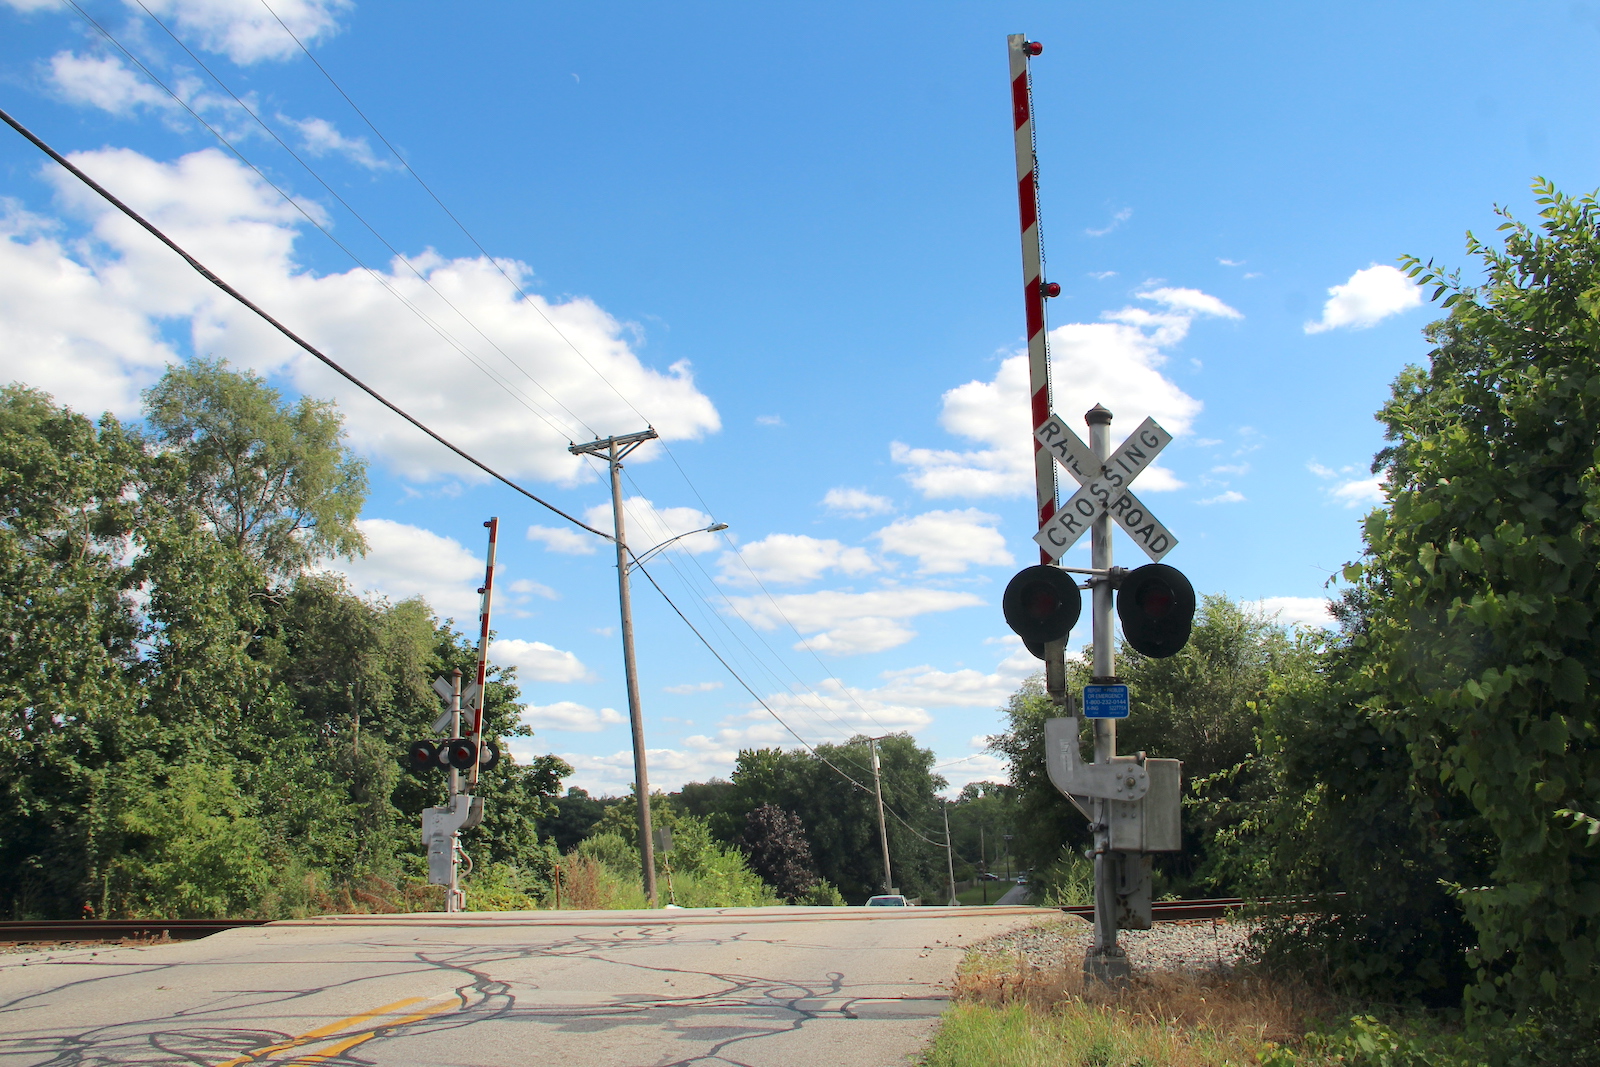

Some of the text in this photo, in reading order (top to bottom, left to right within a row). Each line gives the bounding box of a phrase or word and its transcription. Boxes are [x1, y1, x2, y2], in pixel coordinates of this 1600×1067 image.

[1039, 421, 1082, 476] RAIL
[1047, 430, 1159, 547] CROSSING
[1111, 494, 1169, 554] ROAD
